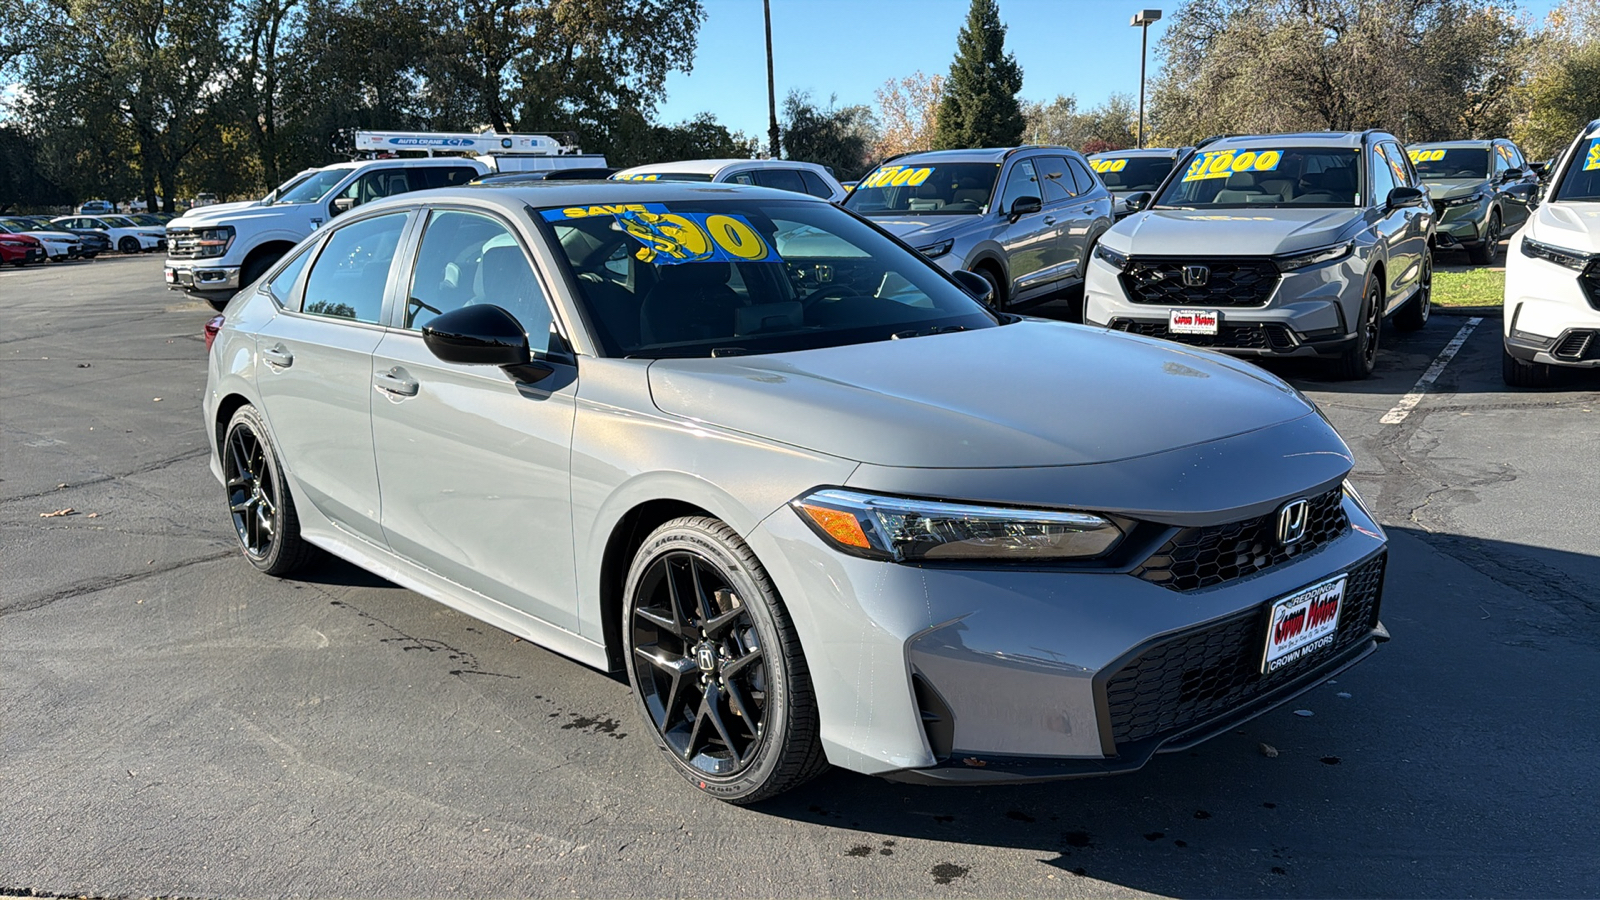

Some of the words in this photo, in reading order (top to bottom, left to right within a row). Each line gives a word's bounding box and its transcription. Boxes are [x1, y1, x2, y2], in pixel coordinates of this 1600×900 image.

[1187, 150, 1280, 176] $1000
[861, 168, 930, 188] $1000
[563, 204, 646, 219] SAVE
[655, 535, 687, 548] EAGLE
[689, 536, 724, 557] SPORT
[1292, 583, 1332, 606] REDDING
[1274, 607, 1306, 645] Crown
[1305, 593, 1340, 631] Motors
[1270, 649, 1300, 671] CROWN
[1301, 634, 1334, 656] MOTORS
